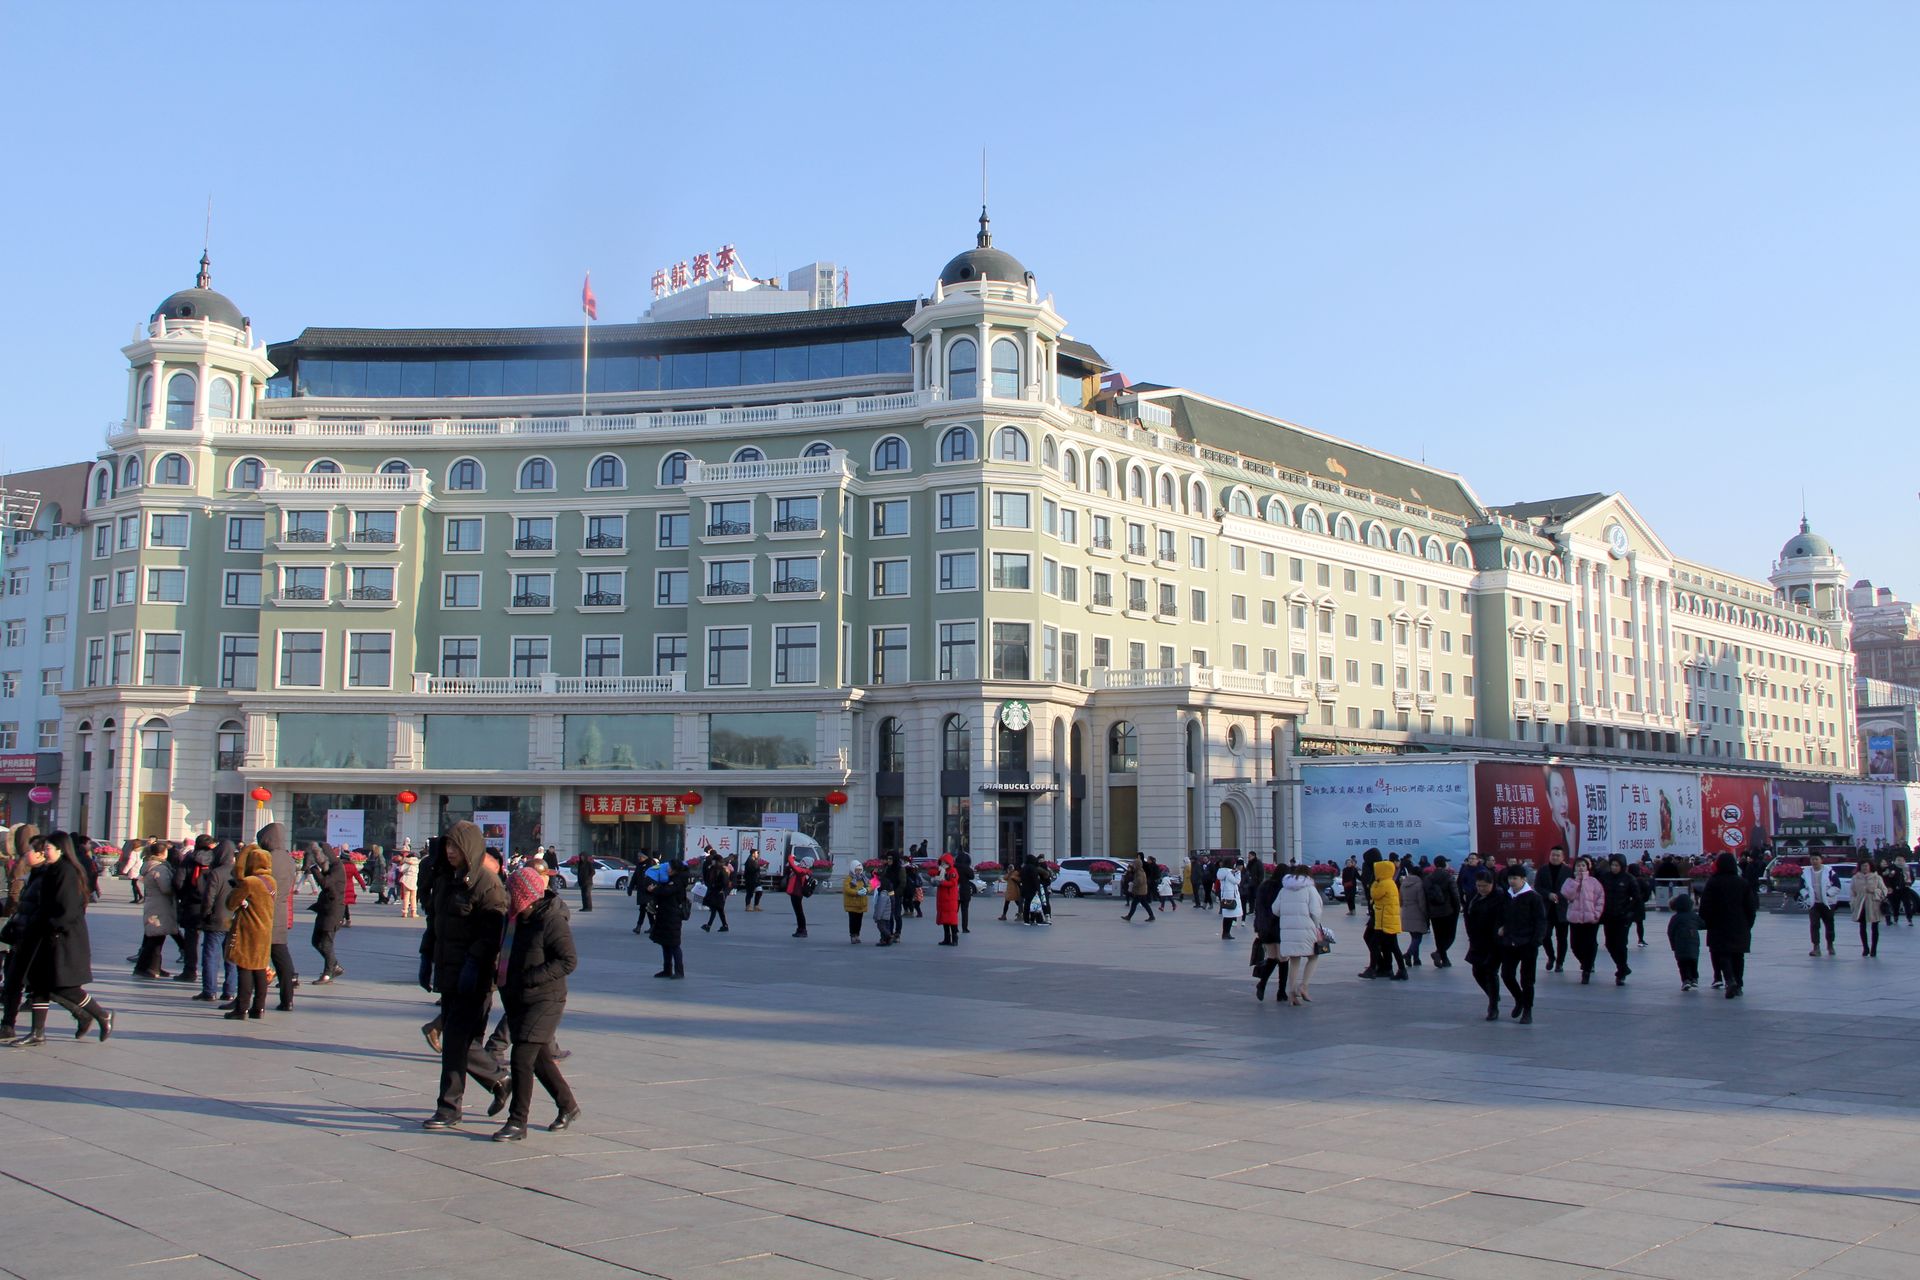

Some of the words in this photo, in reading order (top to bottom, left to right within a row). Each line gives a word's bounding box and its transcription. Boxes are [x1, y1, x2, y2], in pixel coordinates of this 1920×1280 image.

[651, 245, 734, 296] 中航资本
[1495, 783, 1535, 803] 黑龙江瑞丽
[1584, 783, 1607, 812] 瑞丽
[1620, 783, 1651, 804] 广告位
[1493, 806, 1541, 826] 整形美容医院
[1628, 811, 1649, 832] 招商
[1586, 814, 1608, 842] 整形
[697, 834, 777, 852] 小兵搬家
